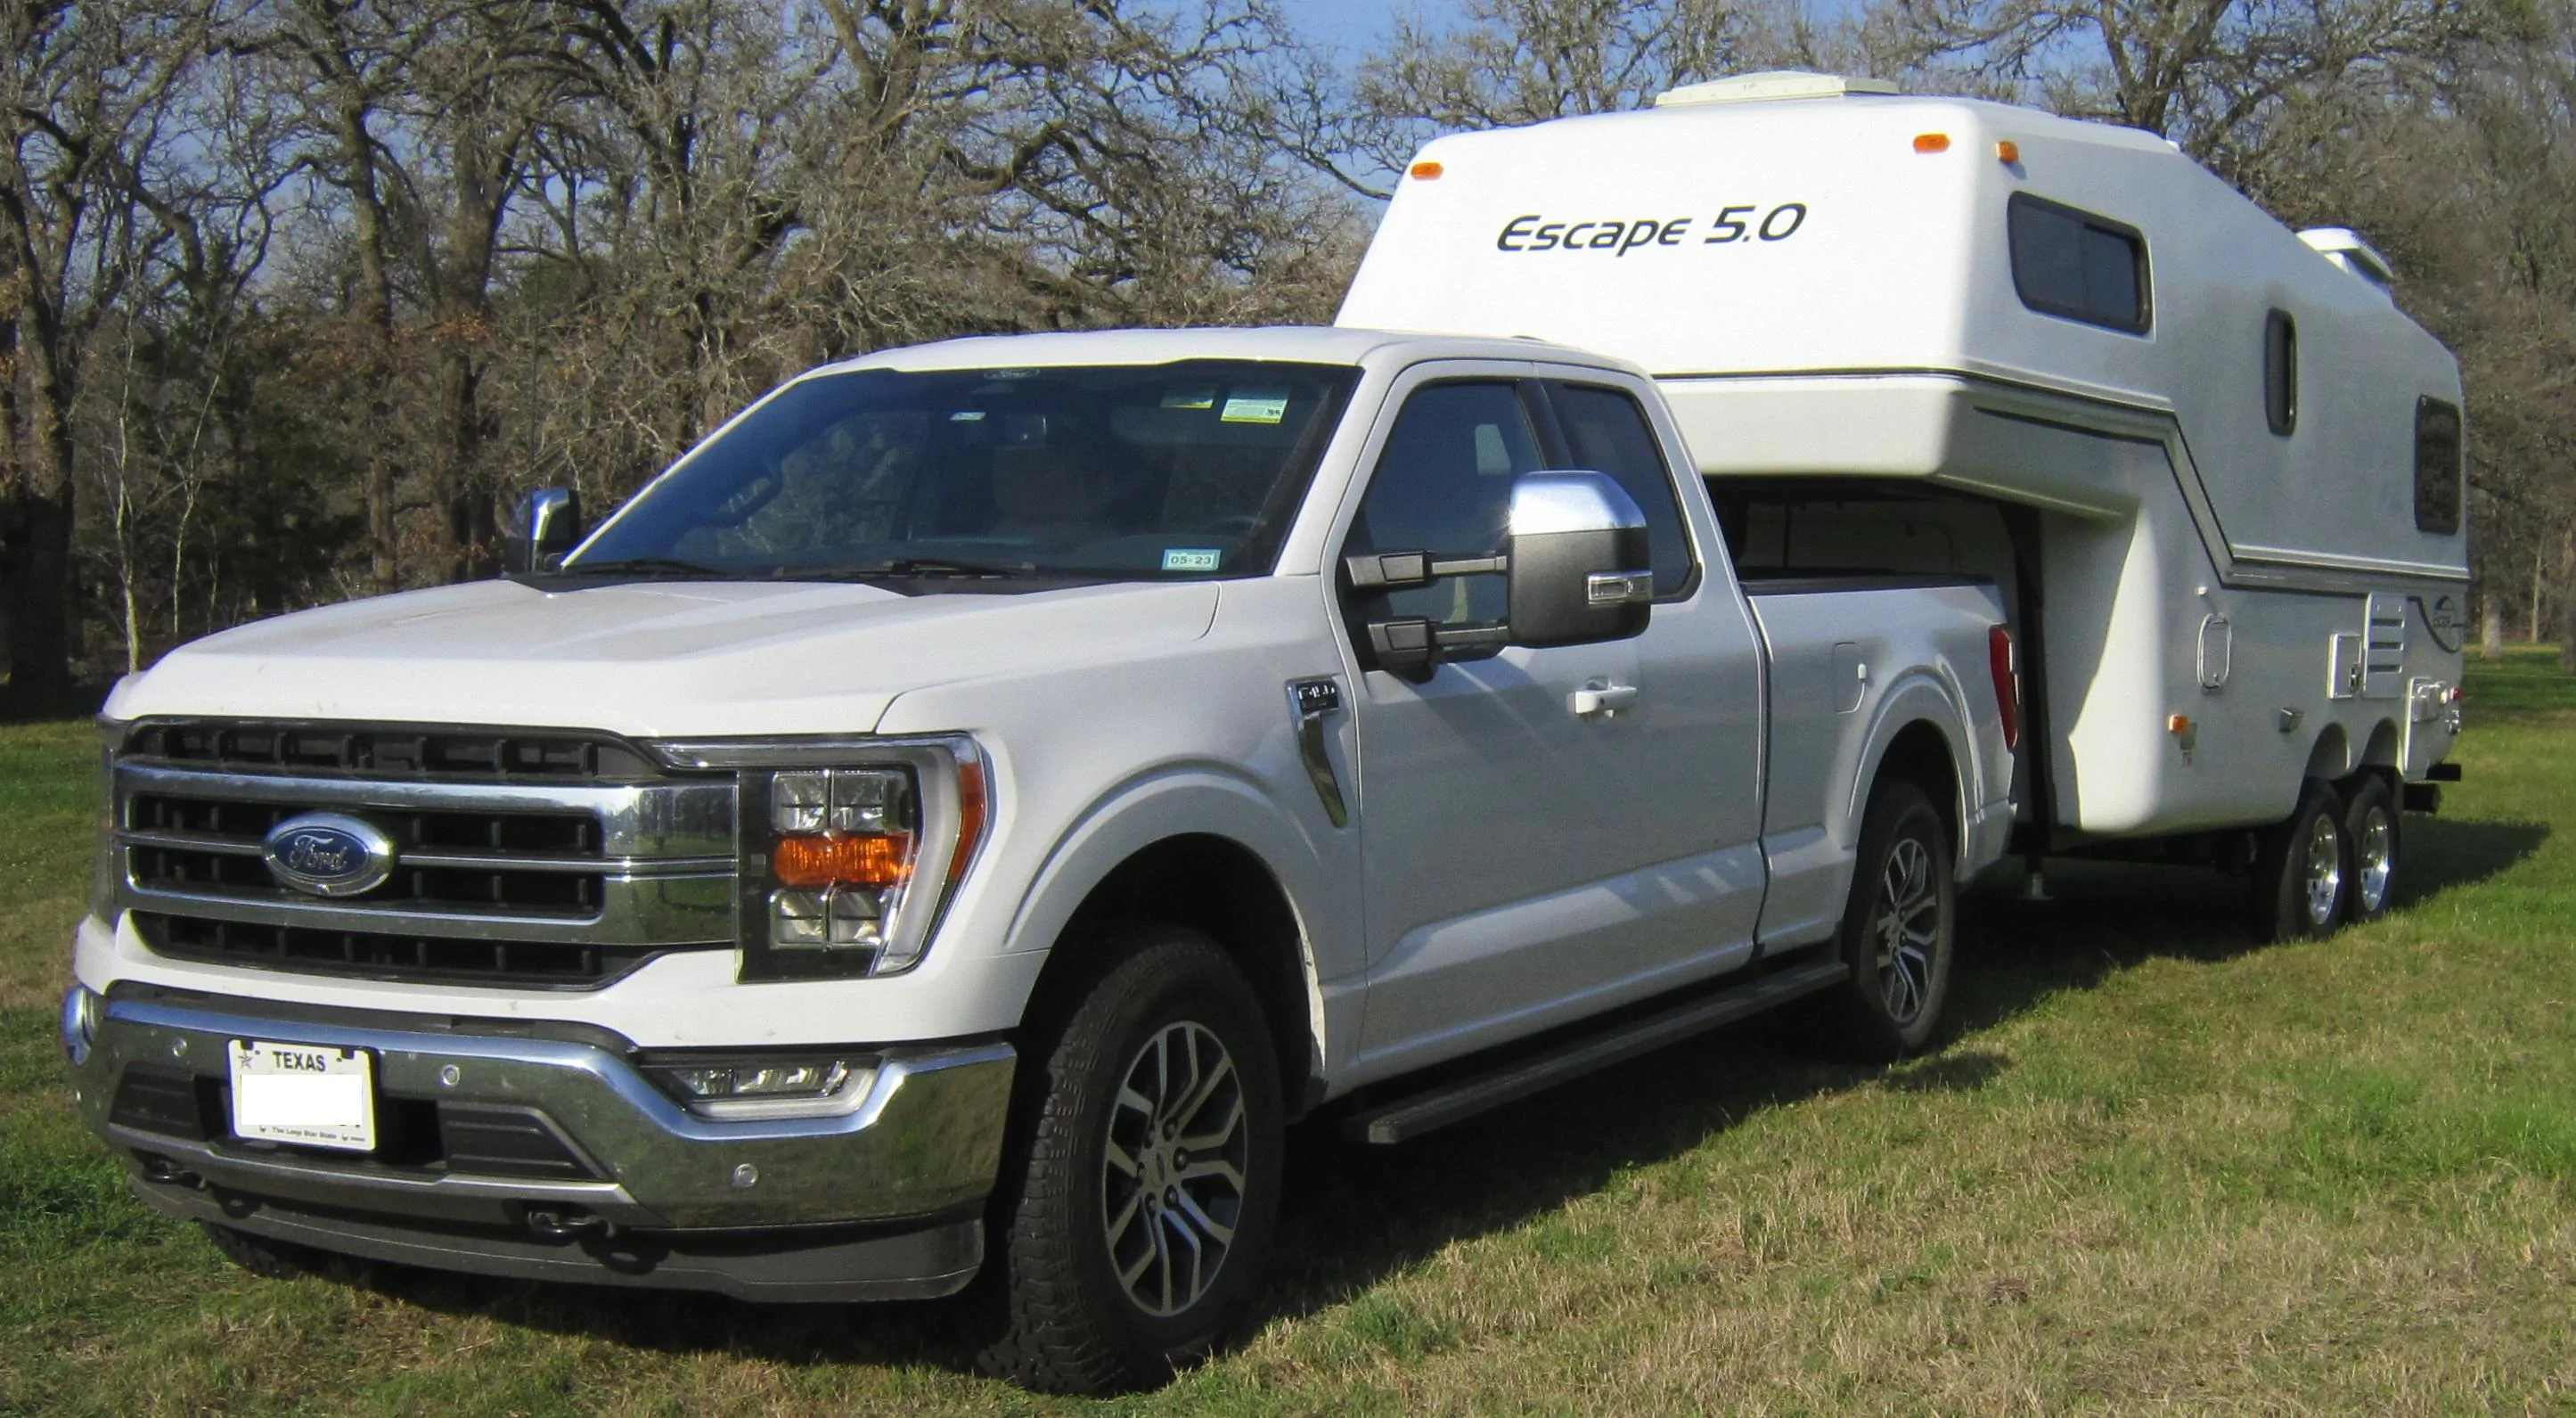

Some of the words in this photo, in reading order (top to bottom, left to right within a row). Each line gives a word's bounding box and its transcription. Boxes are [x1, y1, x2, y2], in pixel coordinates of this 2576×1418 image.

[1497, 214, 1693, 258] Escape
[1704, 202, 1807, 244] 5.0
[289, 834, 348, 871] Ford
[272, 1050, 326, 1072] TEXAS
